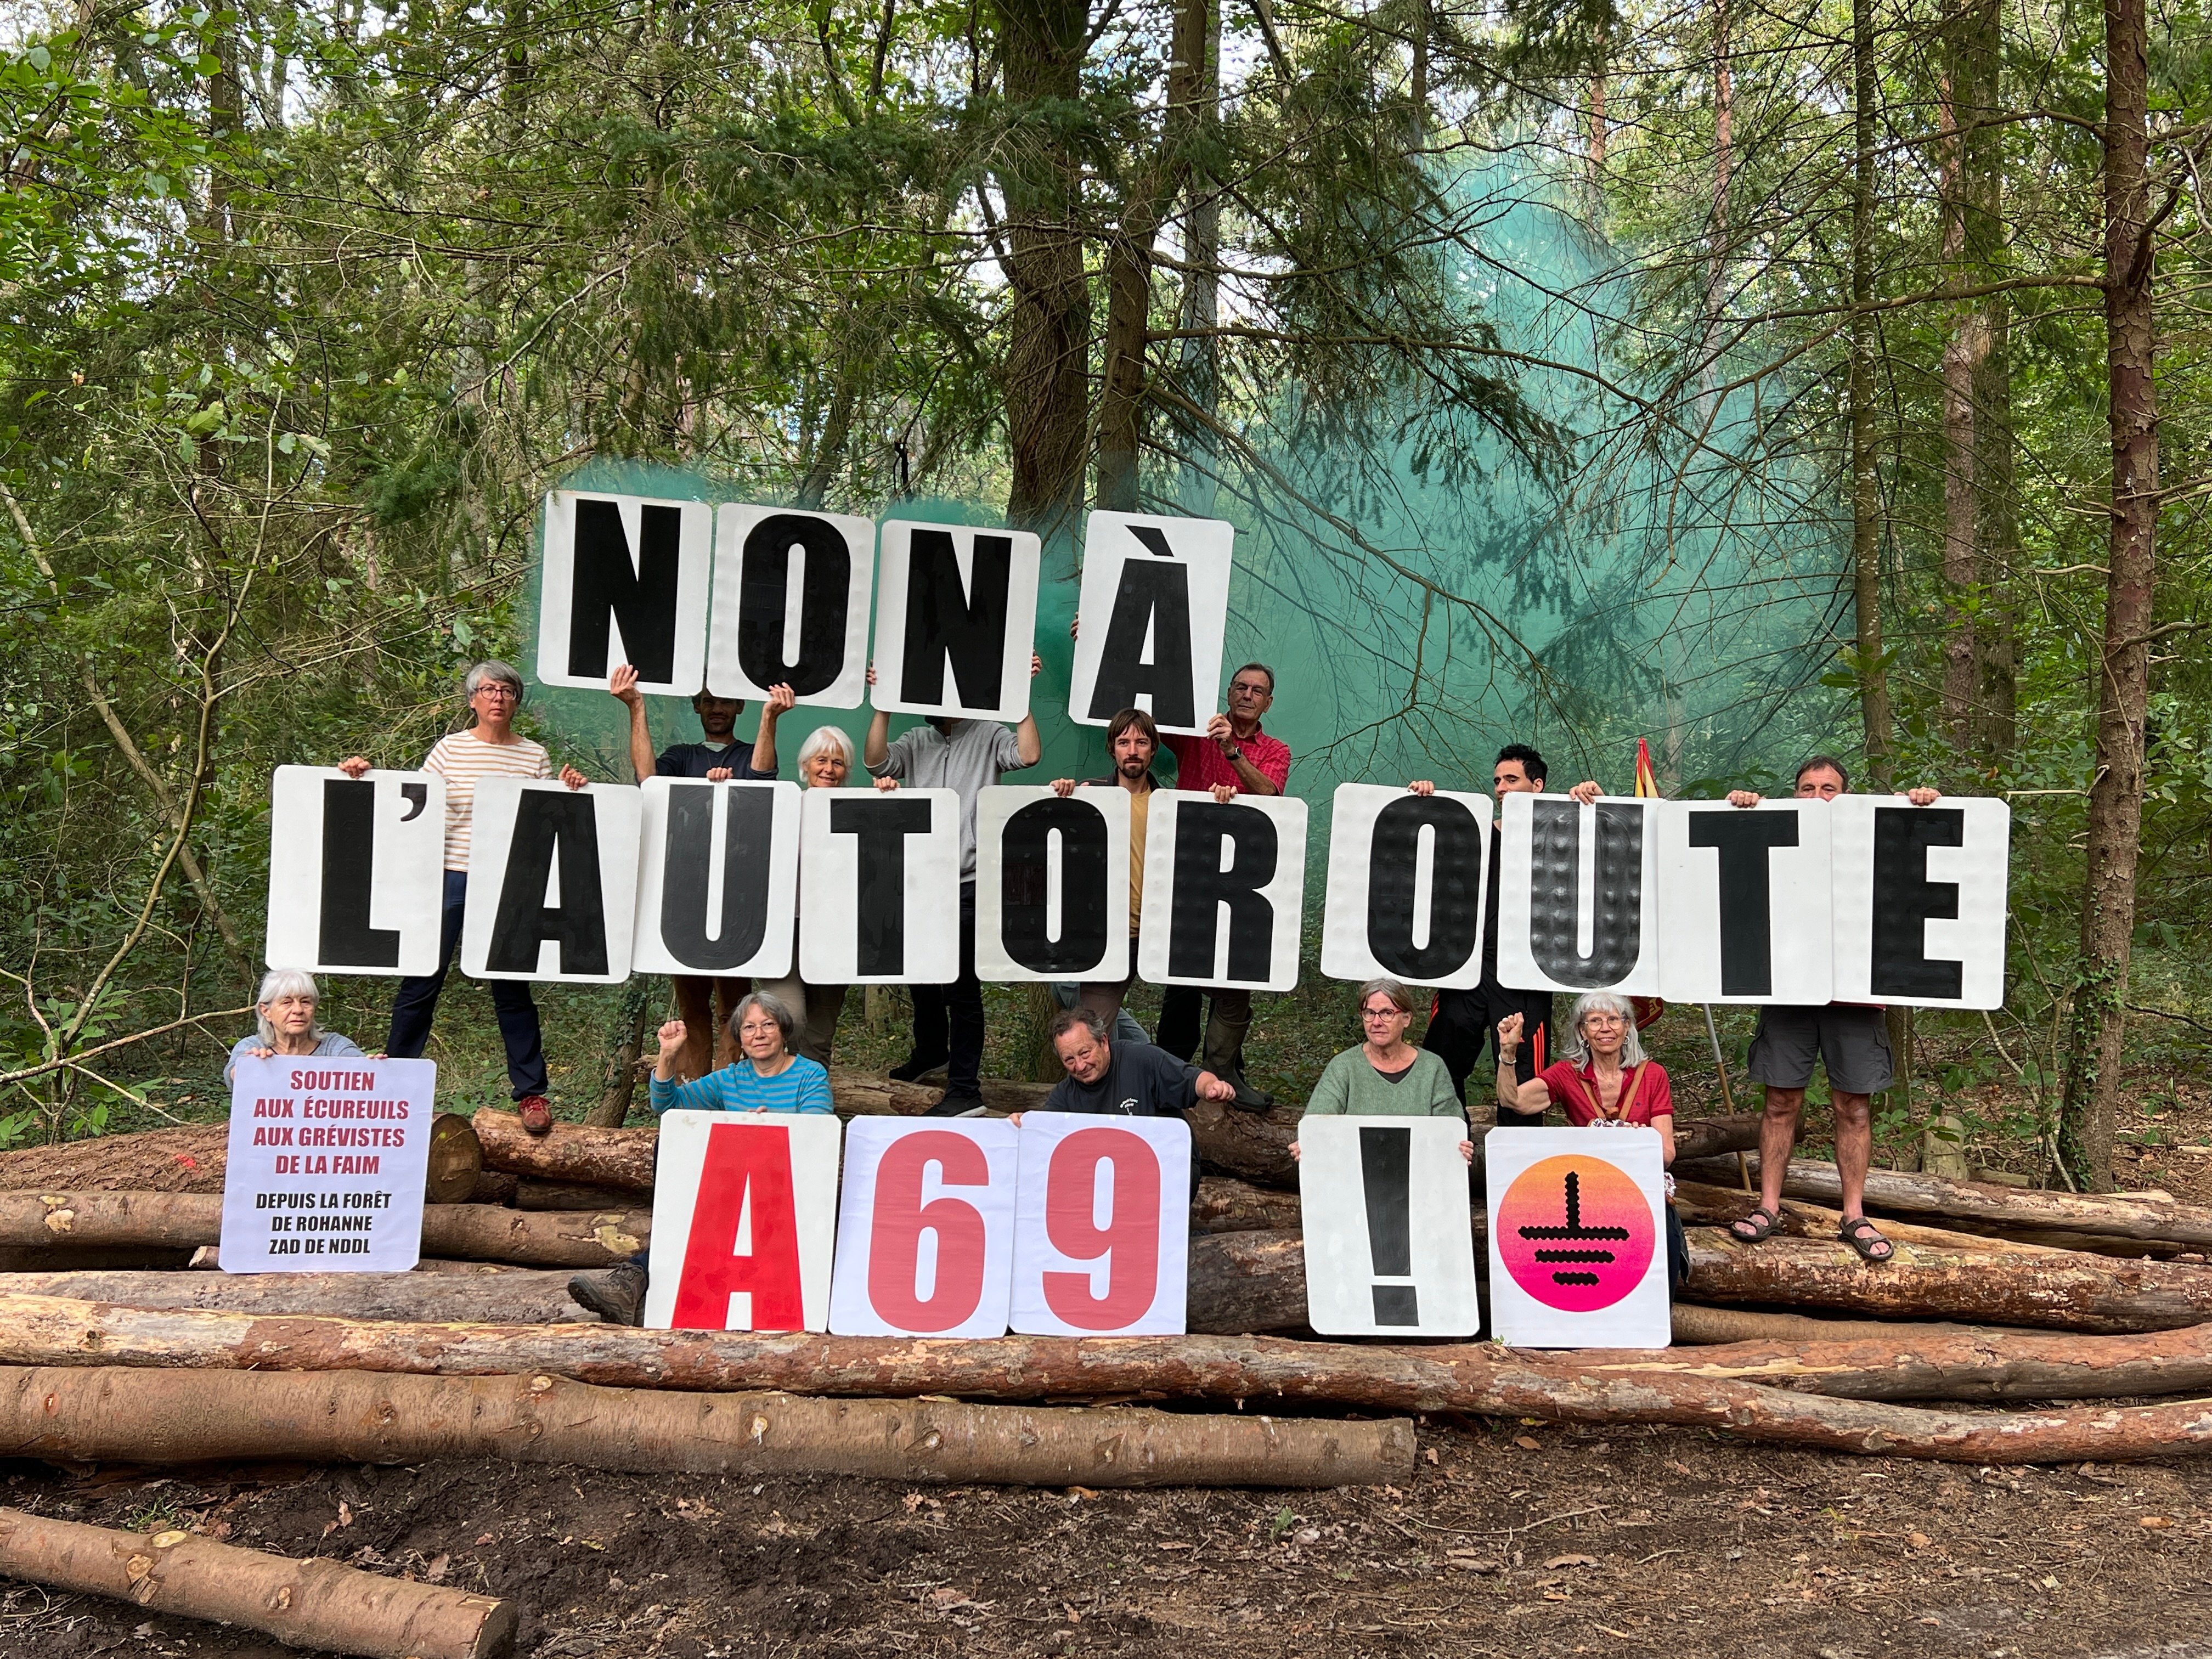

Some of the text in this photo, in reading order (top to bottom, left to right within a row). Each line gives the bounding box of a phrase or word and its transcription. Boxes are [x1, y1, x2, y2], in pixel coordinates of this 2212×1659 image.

[568, 498, 1196, 729] NON À
[290, 1070, 375, 1091] SOUTIEN
[253, 1096, 409, 1120] AUX ÉCUREUILS
[253, 1124, 405, 1147] AUX GRÉVISTES
[275, 1155, 380, 1175] DE LA FAIM
[255, 1190, 392, 1209] DEPUIS LA FORÊT
[271, 1216, 373, 1232] DE ROHANNE
[672, 1122, 1420, 1333] A69 !
[268, 1238, 371, 1255] ZAD DE NDDL
